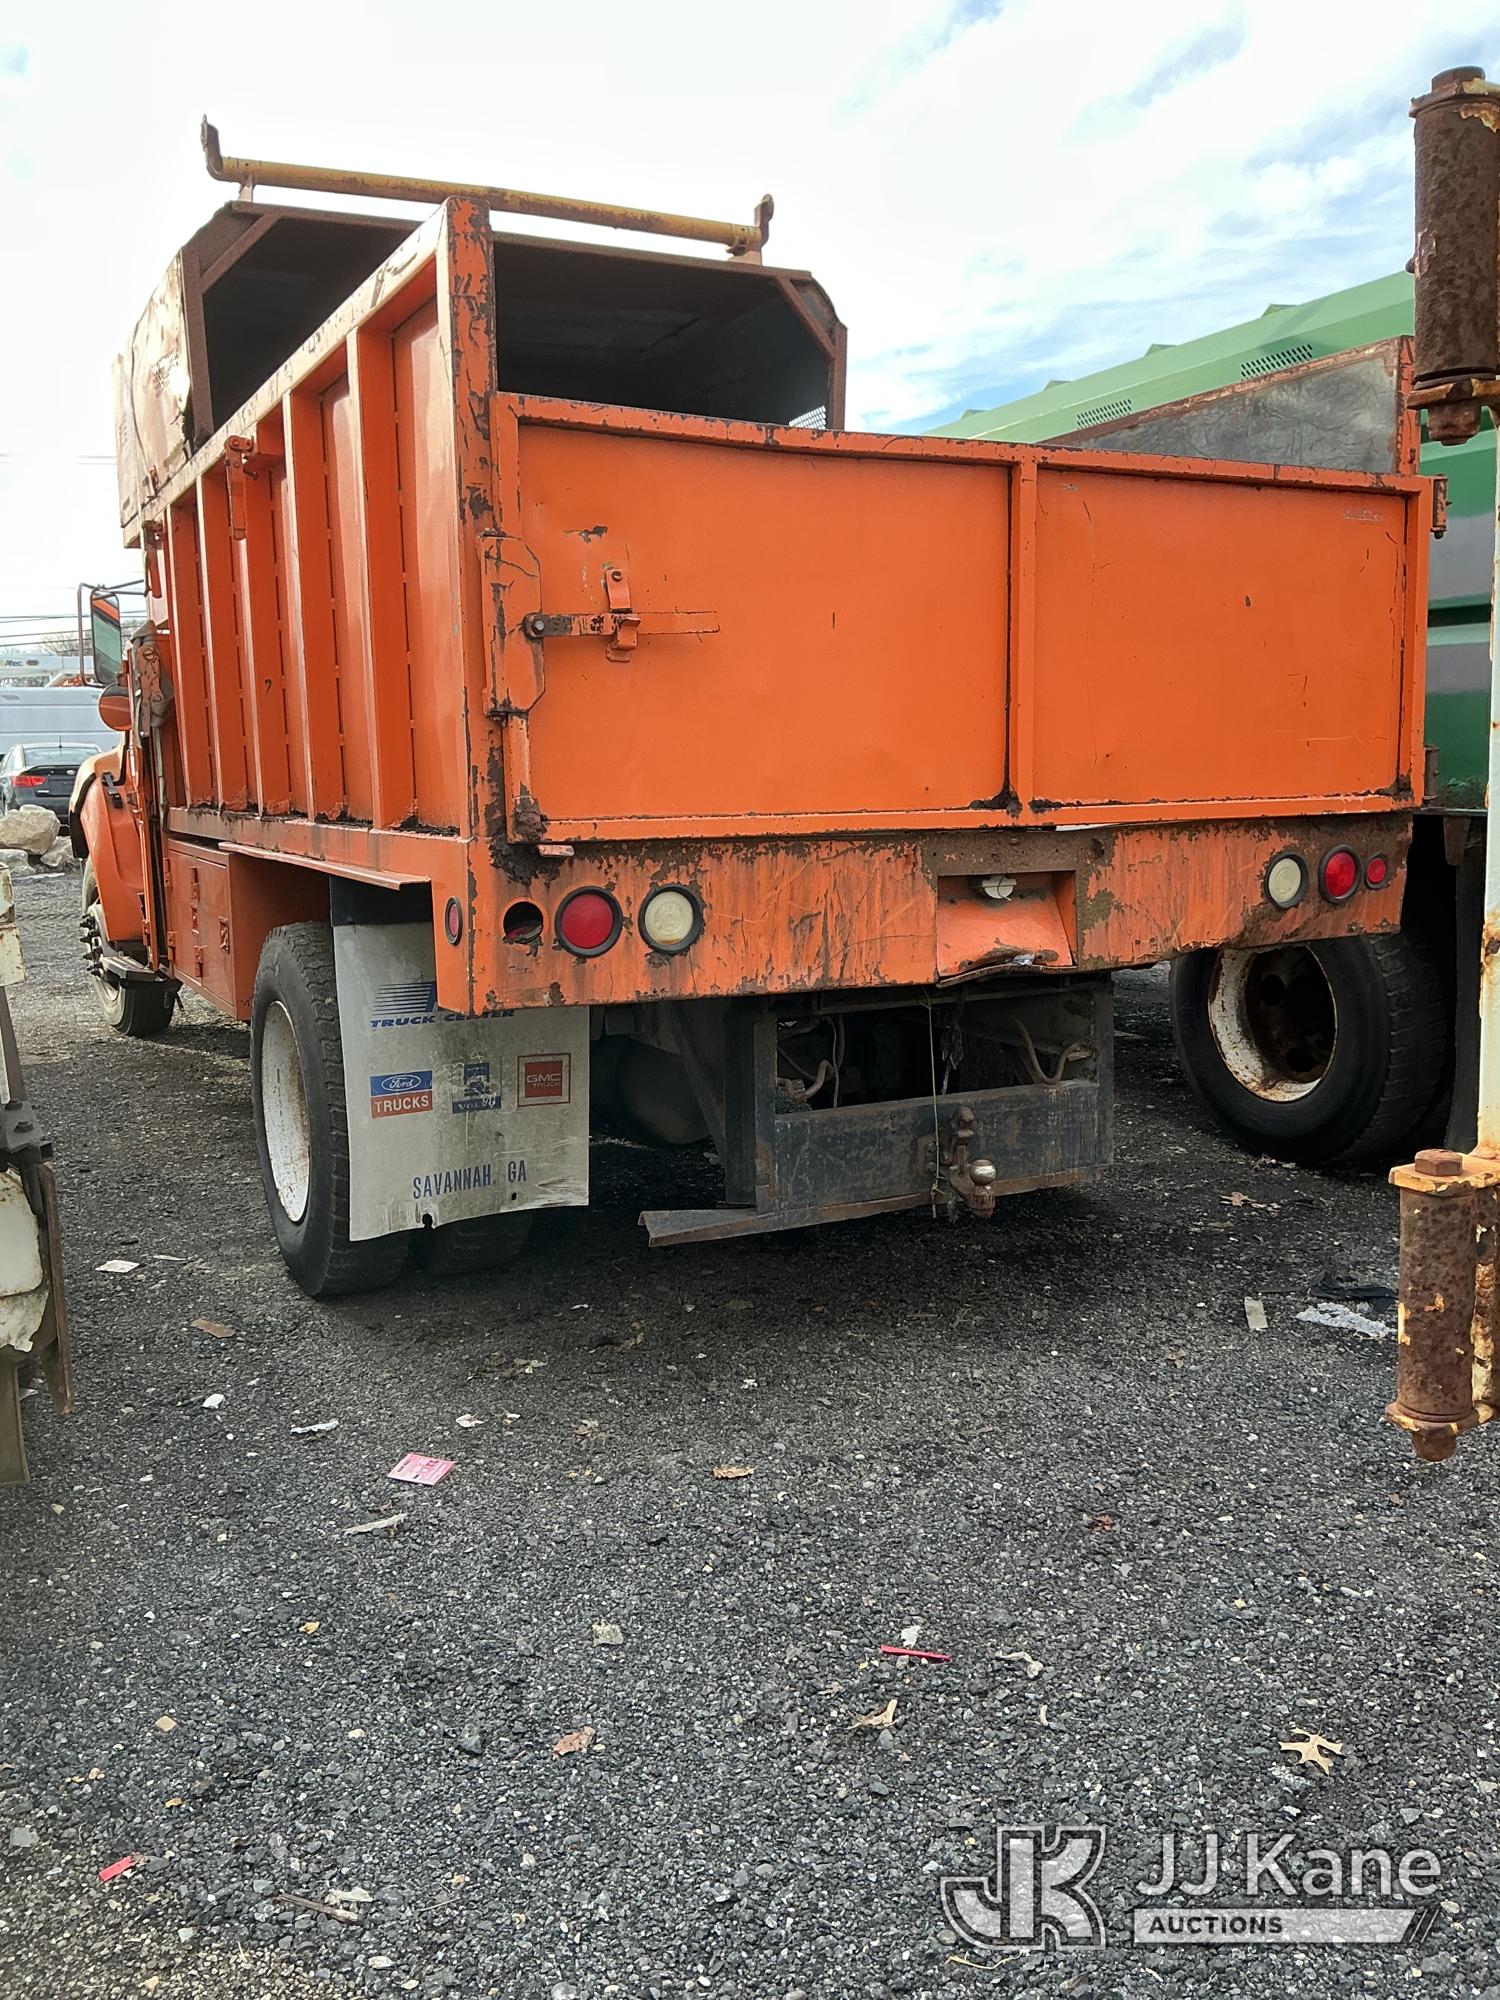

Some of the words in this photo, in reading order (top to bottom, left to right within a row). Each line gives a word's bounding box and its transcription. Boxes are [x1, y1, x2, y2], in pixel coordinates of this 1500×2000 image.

[370, 1016, 435, 1028] TRUCK
[389, 1077, 414, 1089] Ford
[527, 1073, 561, 1083] GMC
[374, 1095, 429, 1113] TRUCKS
[507, 1160, 527, 1183] GA
